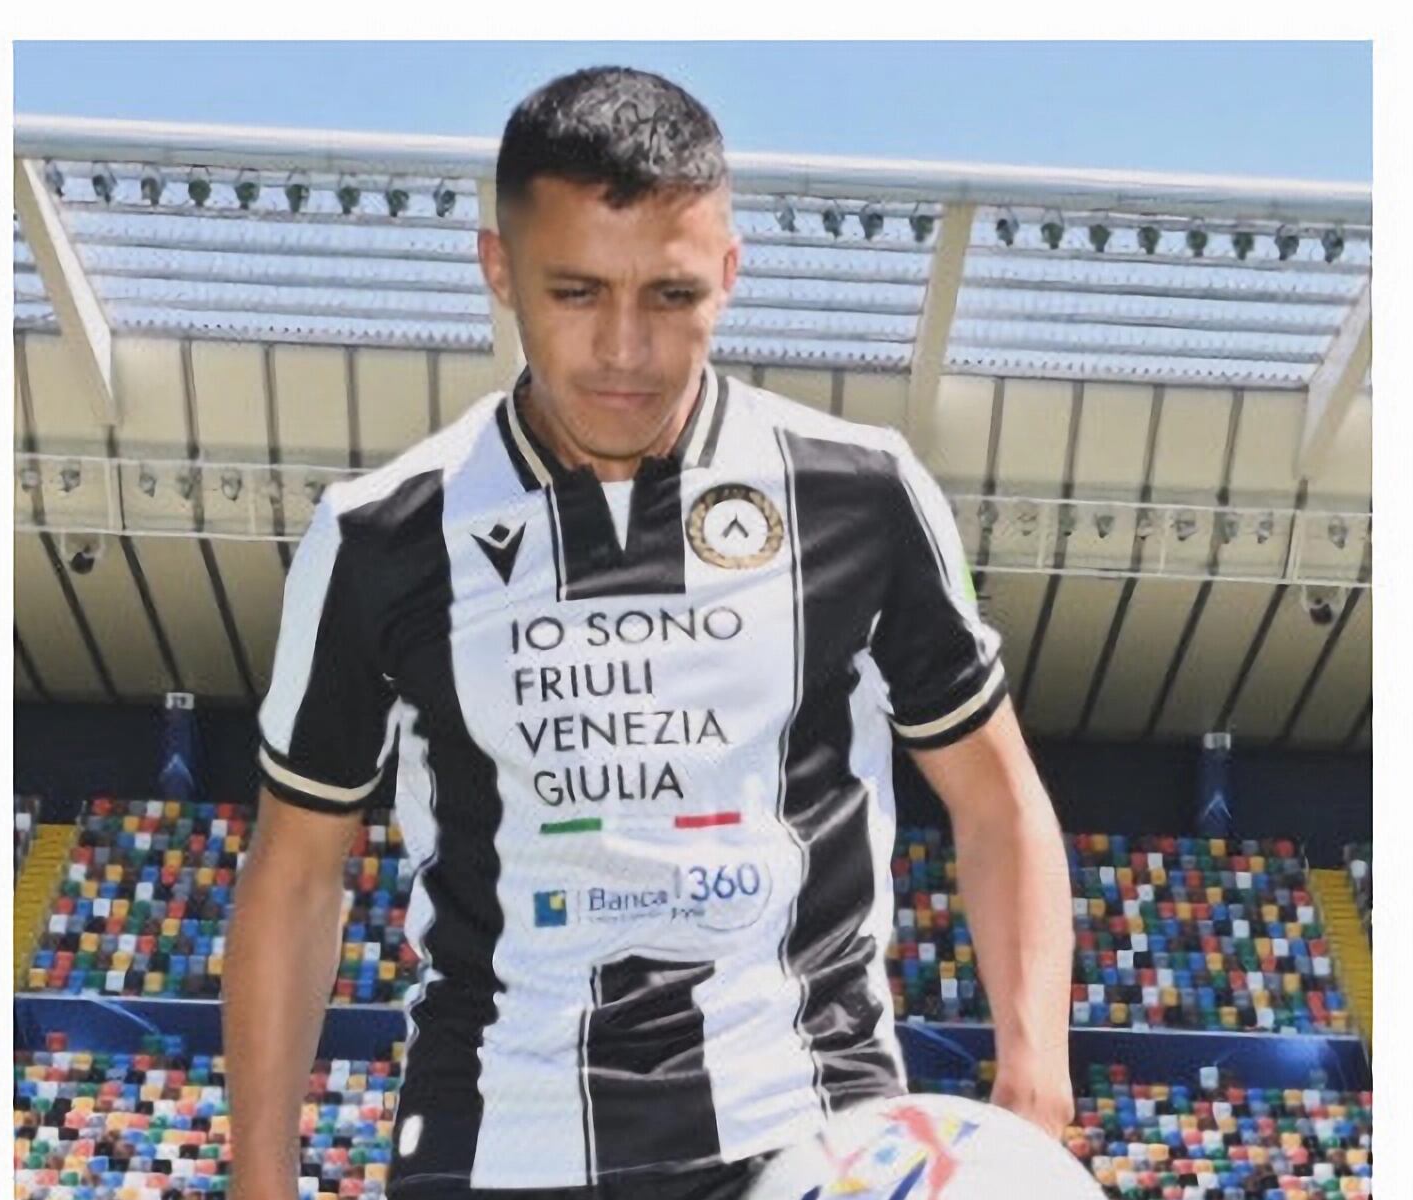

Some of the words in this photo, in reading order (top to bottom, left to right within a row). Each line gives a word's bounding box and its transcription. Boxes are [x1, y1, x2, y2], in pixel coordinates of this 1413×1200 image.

[511, 615, 565, 654] IO
[586, 606, 743, 647] SONO
[514, 658, 654, 706] FRIULI
[516, 708, 730, 758] VENEZIA
[534, 762, 684, 807] GIULIA
[588, 887, 669, 912] Banca
[688, 863, 761, 902] 360
